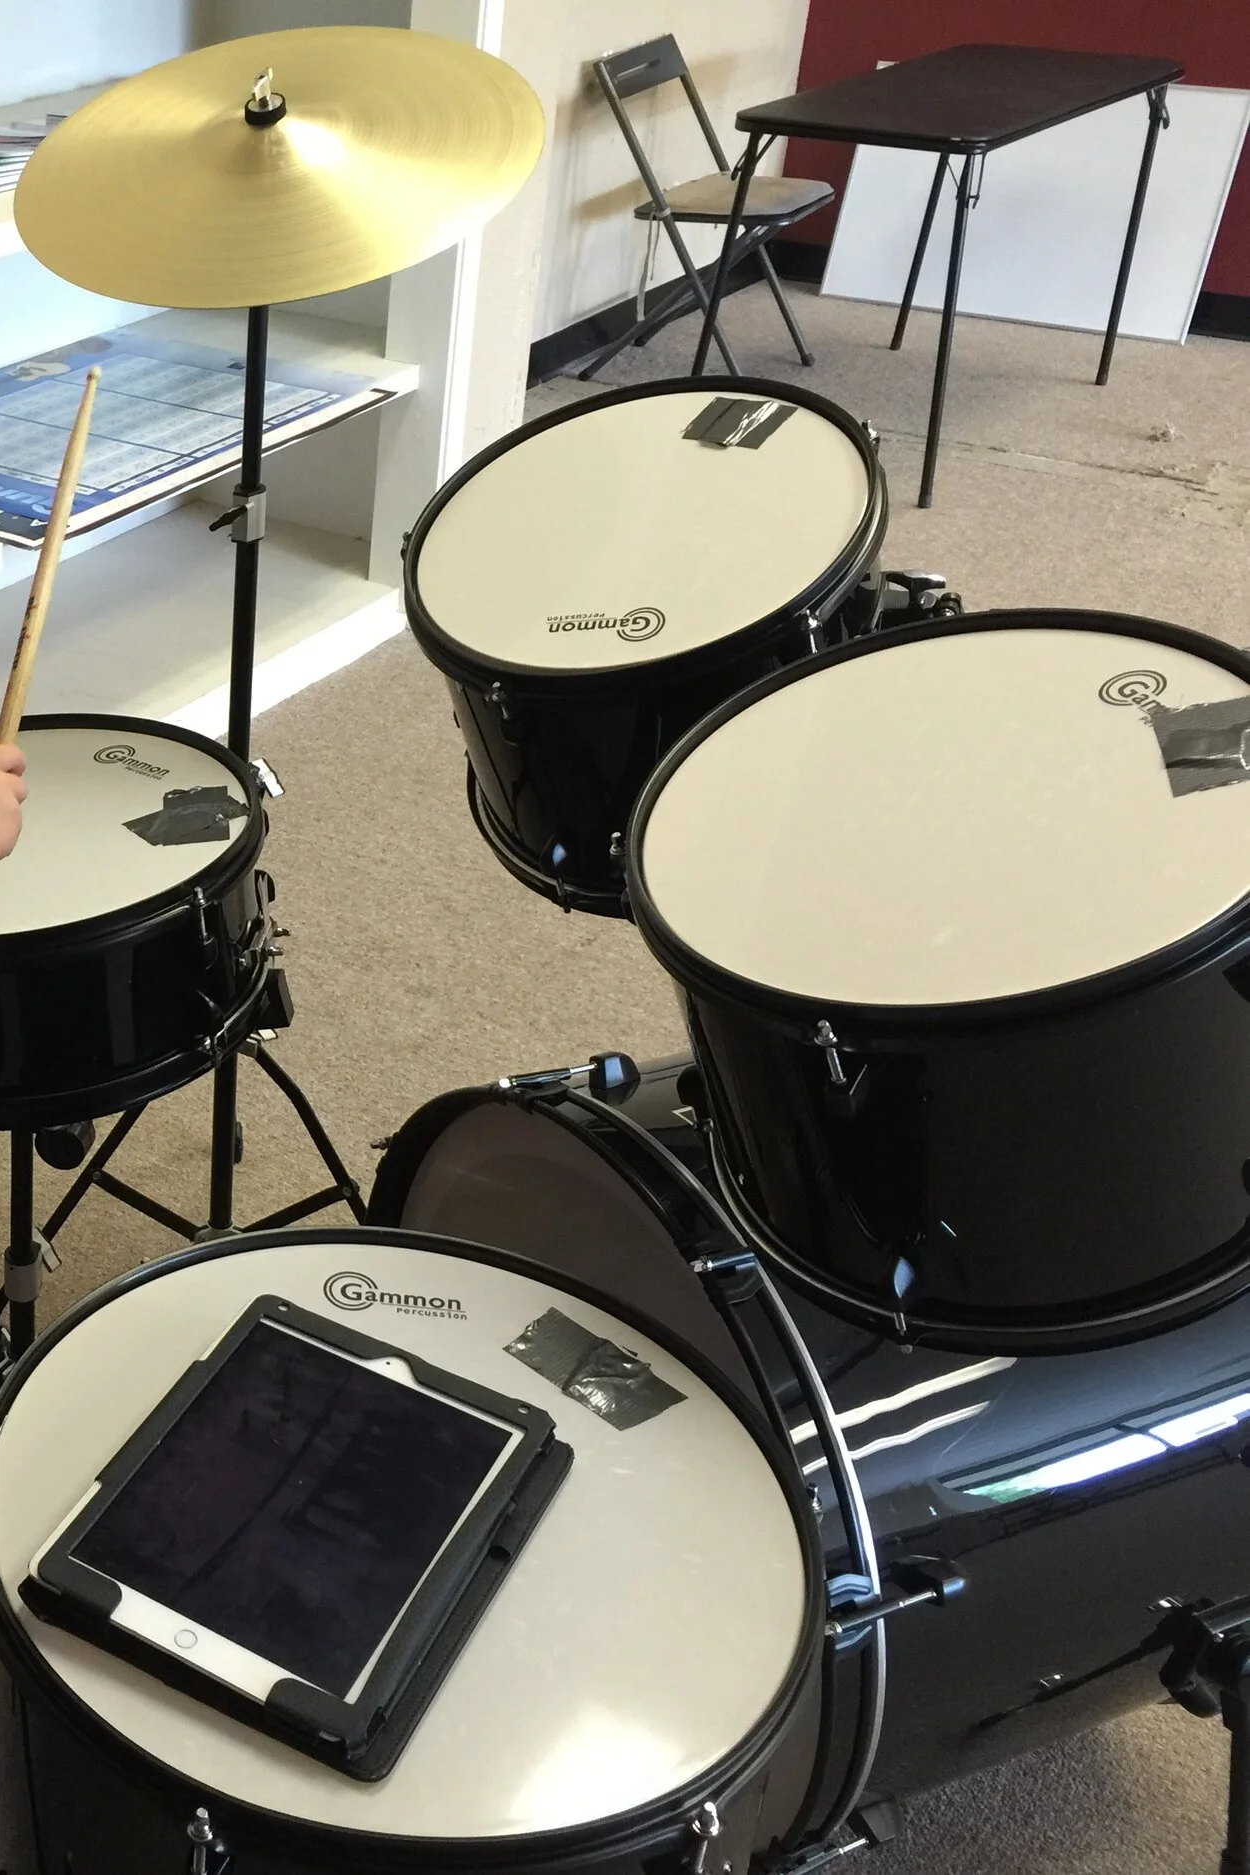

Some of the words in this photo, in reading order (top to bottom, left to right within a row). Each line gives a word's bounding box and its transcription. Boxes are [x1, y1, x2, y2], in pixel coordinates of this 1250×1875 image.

[548, 616, 652, 634] Gammon
[105, 750, 170, 776] Gammon
[339, 1282, 462, 1311] Gammon
